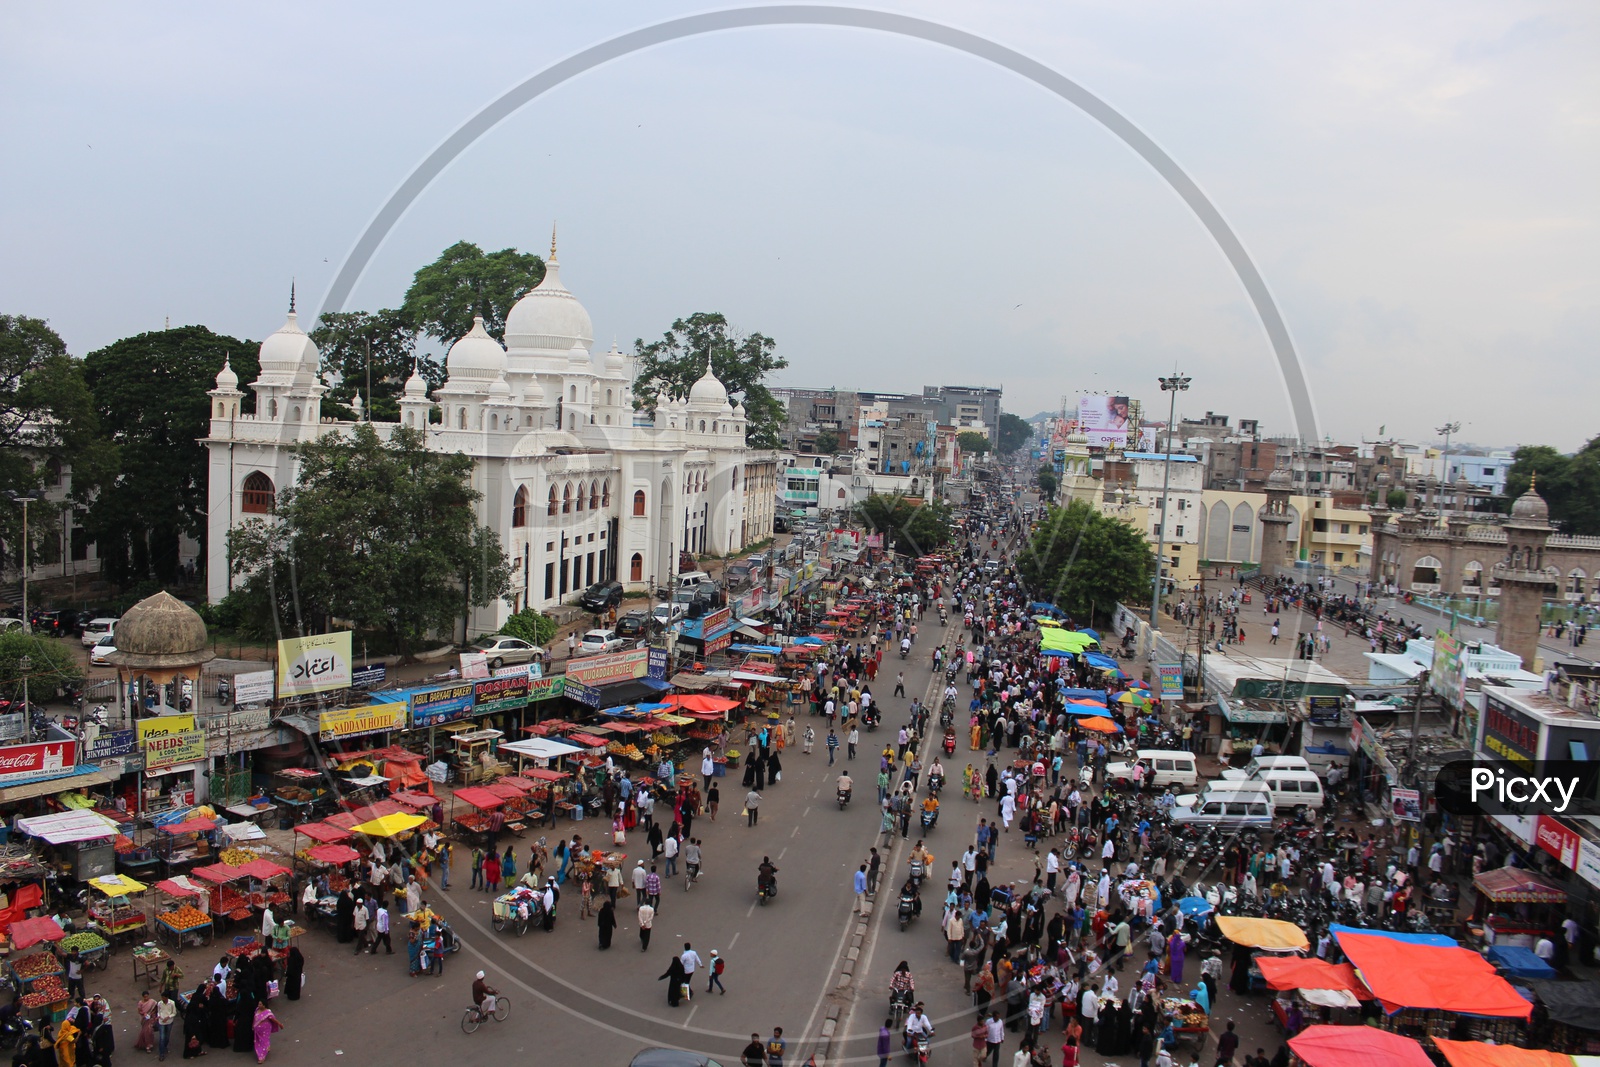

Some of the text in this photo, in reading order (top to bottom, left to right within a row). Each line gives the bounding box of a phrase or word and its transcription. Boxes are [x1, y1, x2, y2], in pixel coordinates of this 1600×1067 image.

[649, 651, 667, 660] KALYANI
[495, 665, 528, 676] MUNNU
[583, 667, 614, 681] MUQADDAR
[615, 663, 633, 675] HOTEL
[475, 677, 528, 695] ROSHAN
[528, 678, 552, 691] UNNU
[452, 686, 472, 698] BAKERY
[480, 692, 500, 702] Sweet
[503, 688, 523, 698] House
[334, 719, 366, 734] SADDAM
[368, 714, 394, 729] HOTEL
[94, 739, 112, 749] LYANI
[149, 736, 184, 753] NEEDS
[86, 748, 111, 759] BIRYANI
